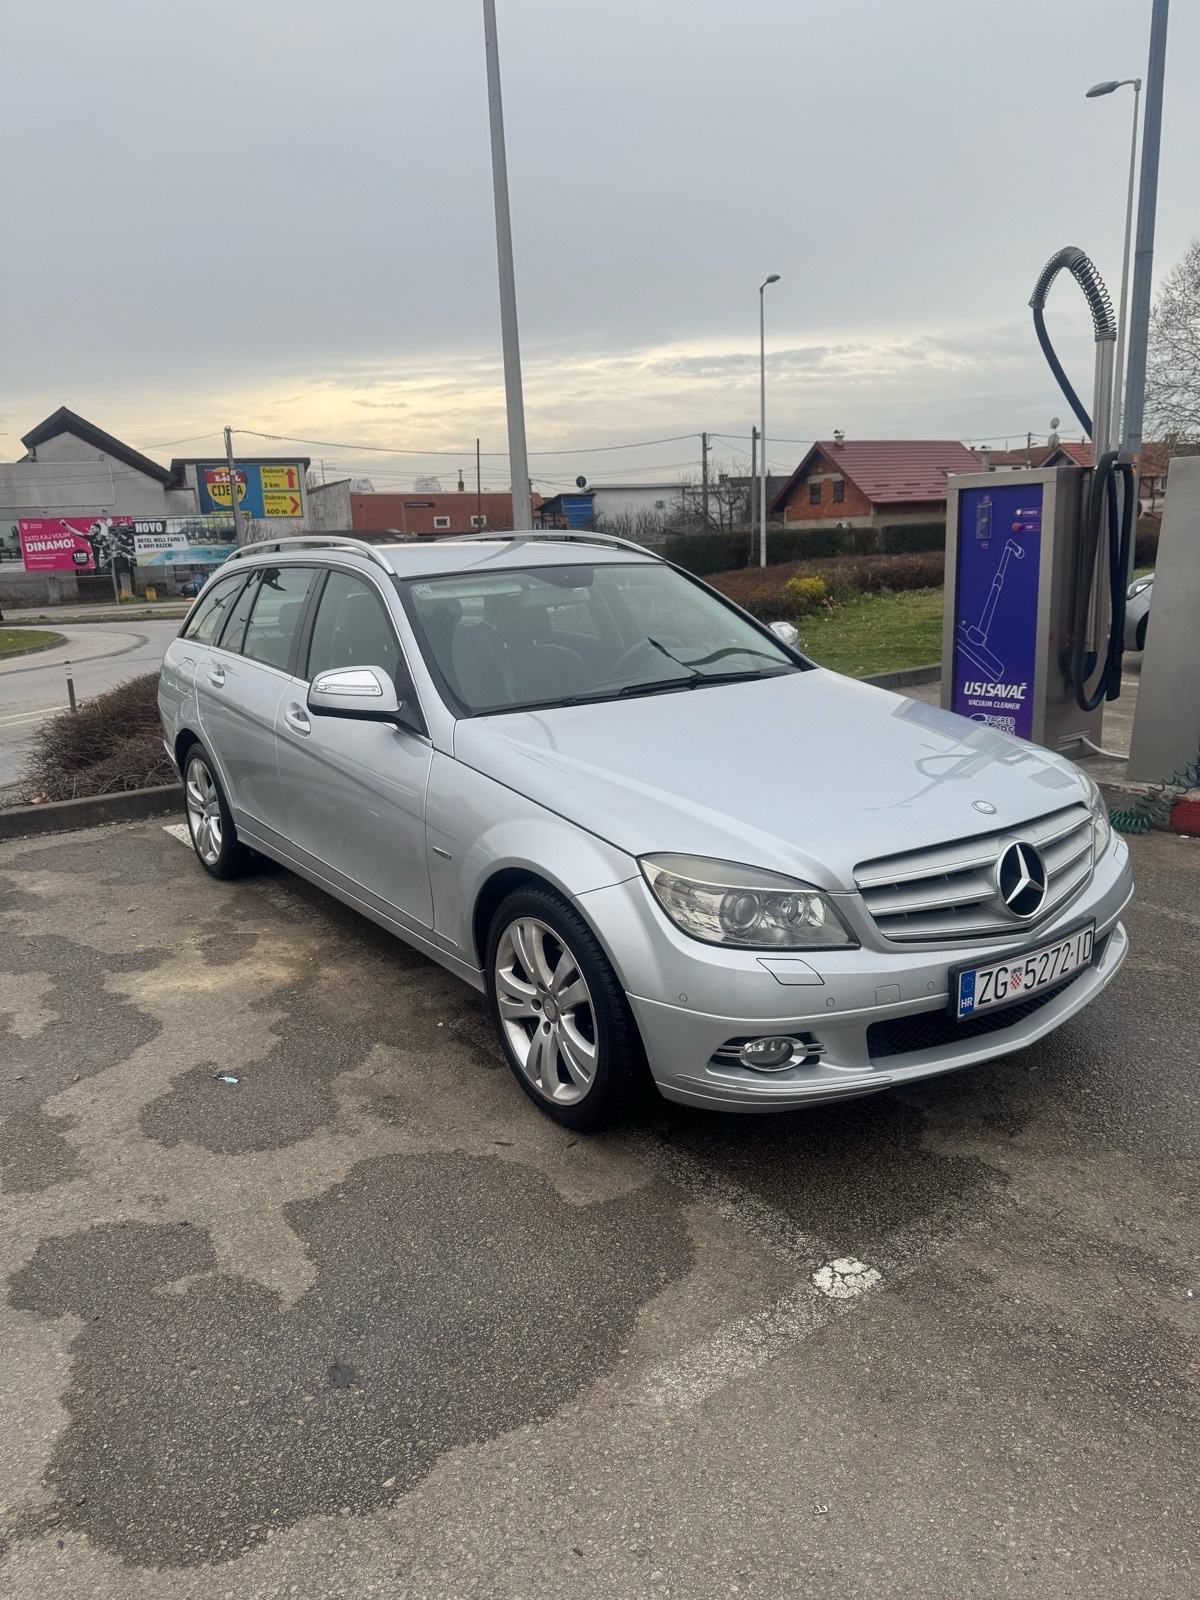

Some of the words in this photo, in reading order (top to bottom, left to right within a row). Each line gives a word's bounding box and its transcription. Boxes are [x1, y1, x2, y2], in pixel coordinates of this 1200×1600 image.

[212, 485, 243, 496] CIJEA
[135, 522, 163, 533] NOVO
[24, 534, 40, 542] ZATO
[26, 539, 75, 552] DINAMO!
[963, 681, 1028, 700] USISAVAČ
[968, 699, 993, 708] VACUUM
[993, 701, 1021, 710] CLEANER
[986, 715, 1015, 725] ZAGREB
[977, 966, 1009, 1005] ZG
[961, 996, 973, 1009] HR
